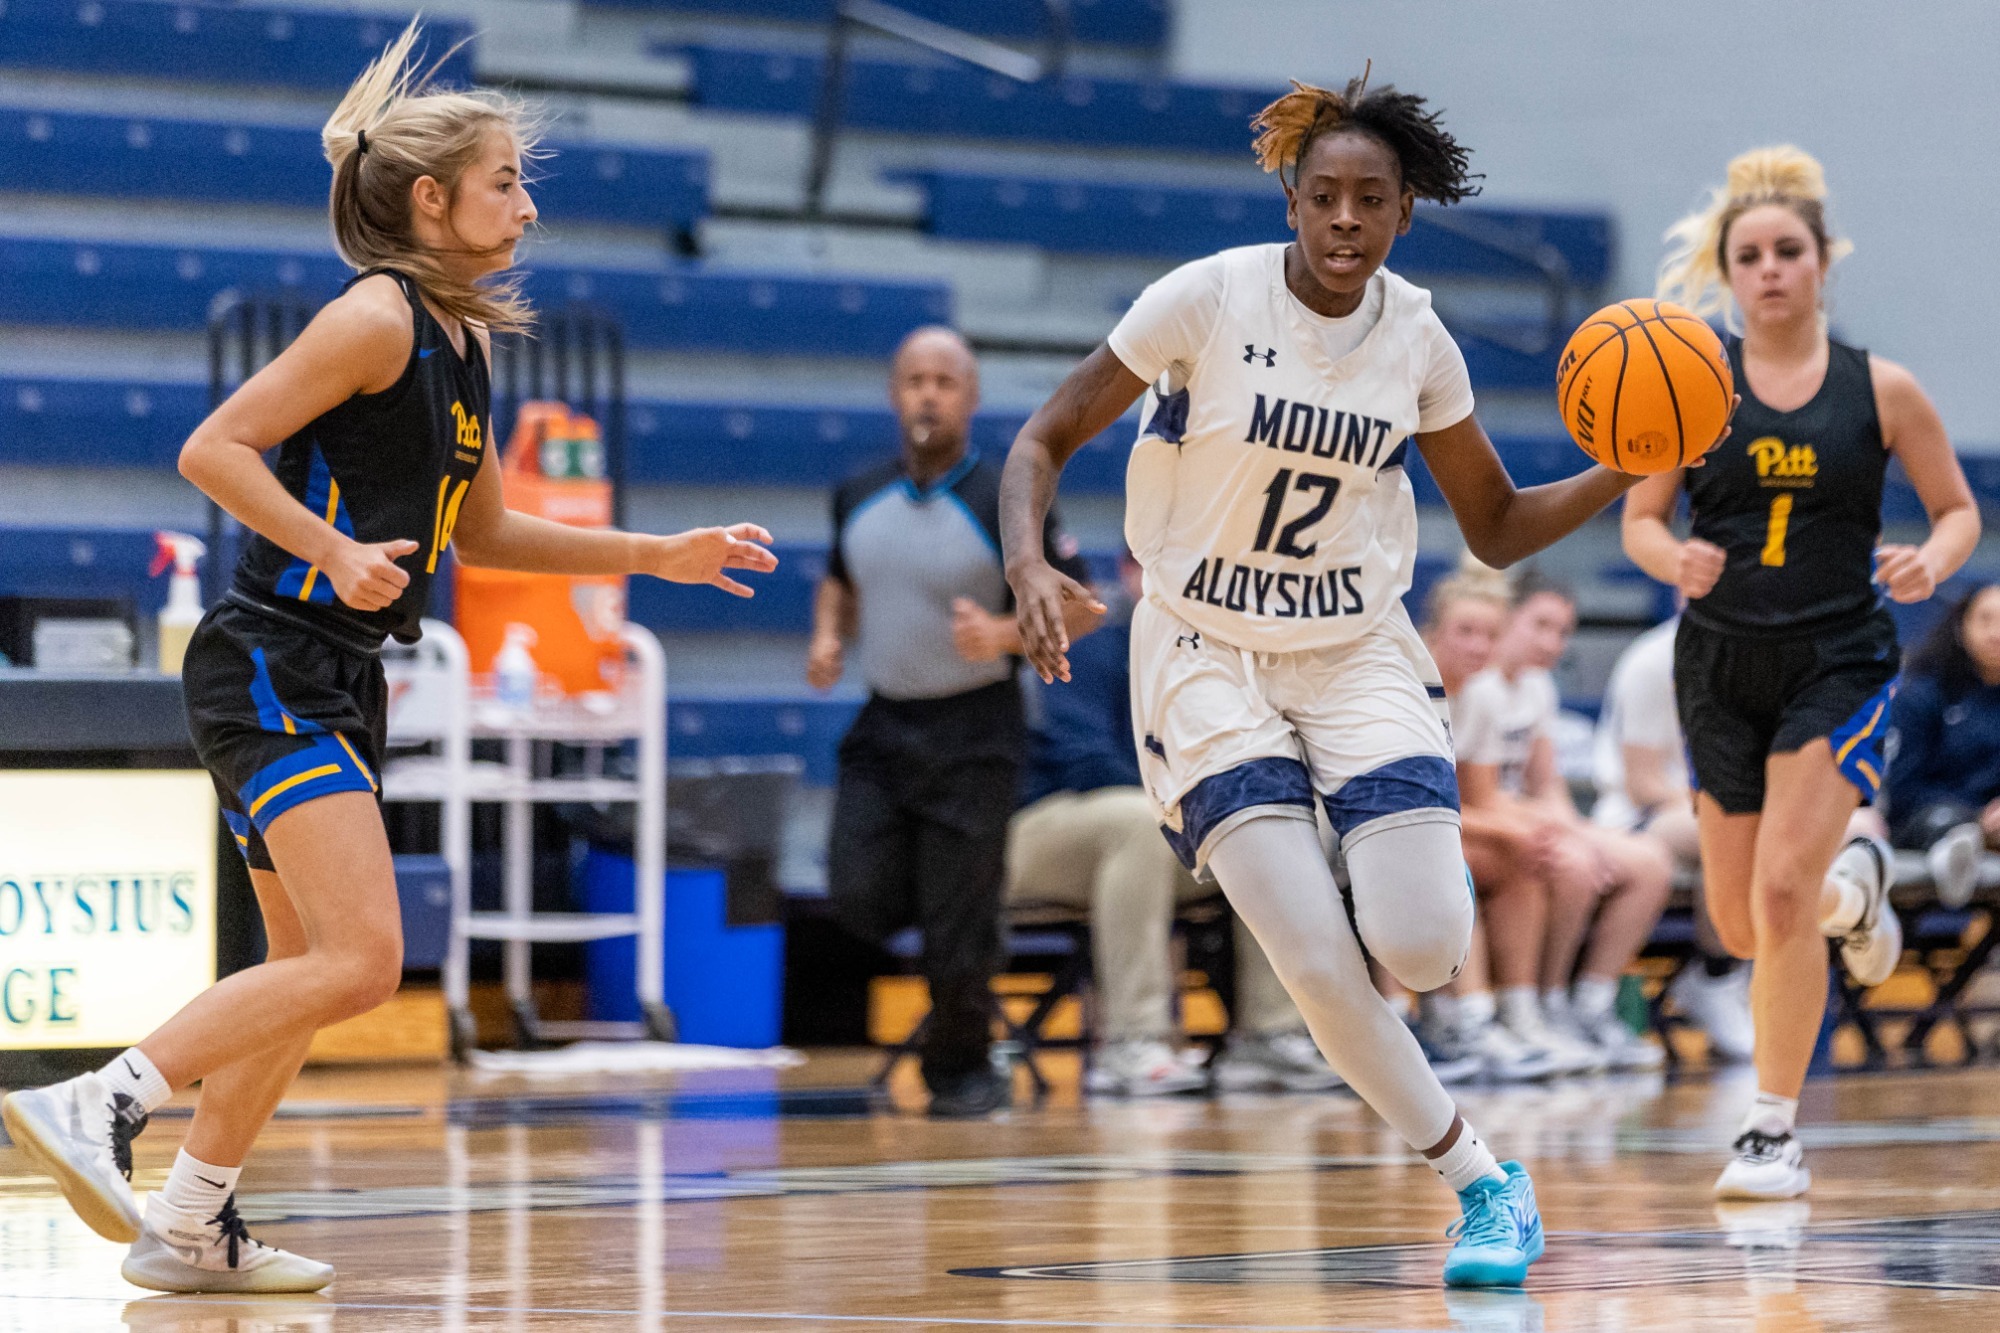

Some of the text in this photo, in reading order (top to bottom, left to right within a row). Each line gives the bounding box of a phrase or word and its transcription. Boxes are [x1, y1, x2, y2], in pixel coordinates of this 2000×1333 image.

[1244, 392, 1392, 468] MOUNT
[1747, 436, 1819, 477] Pitt
[426, 474, 471, 574] 14
[1251, 467, 1342, 560] 12
[1760, 492, 1794, 567] 1
[1182, 557, 1364, 618] ALOYSIUS
[0, 876, 195, 936] OYSIUS
[3, 967, 76, 1024] GE
